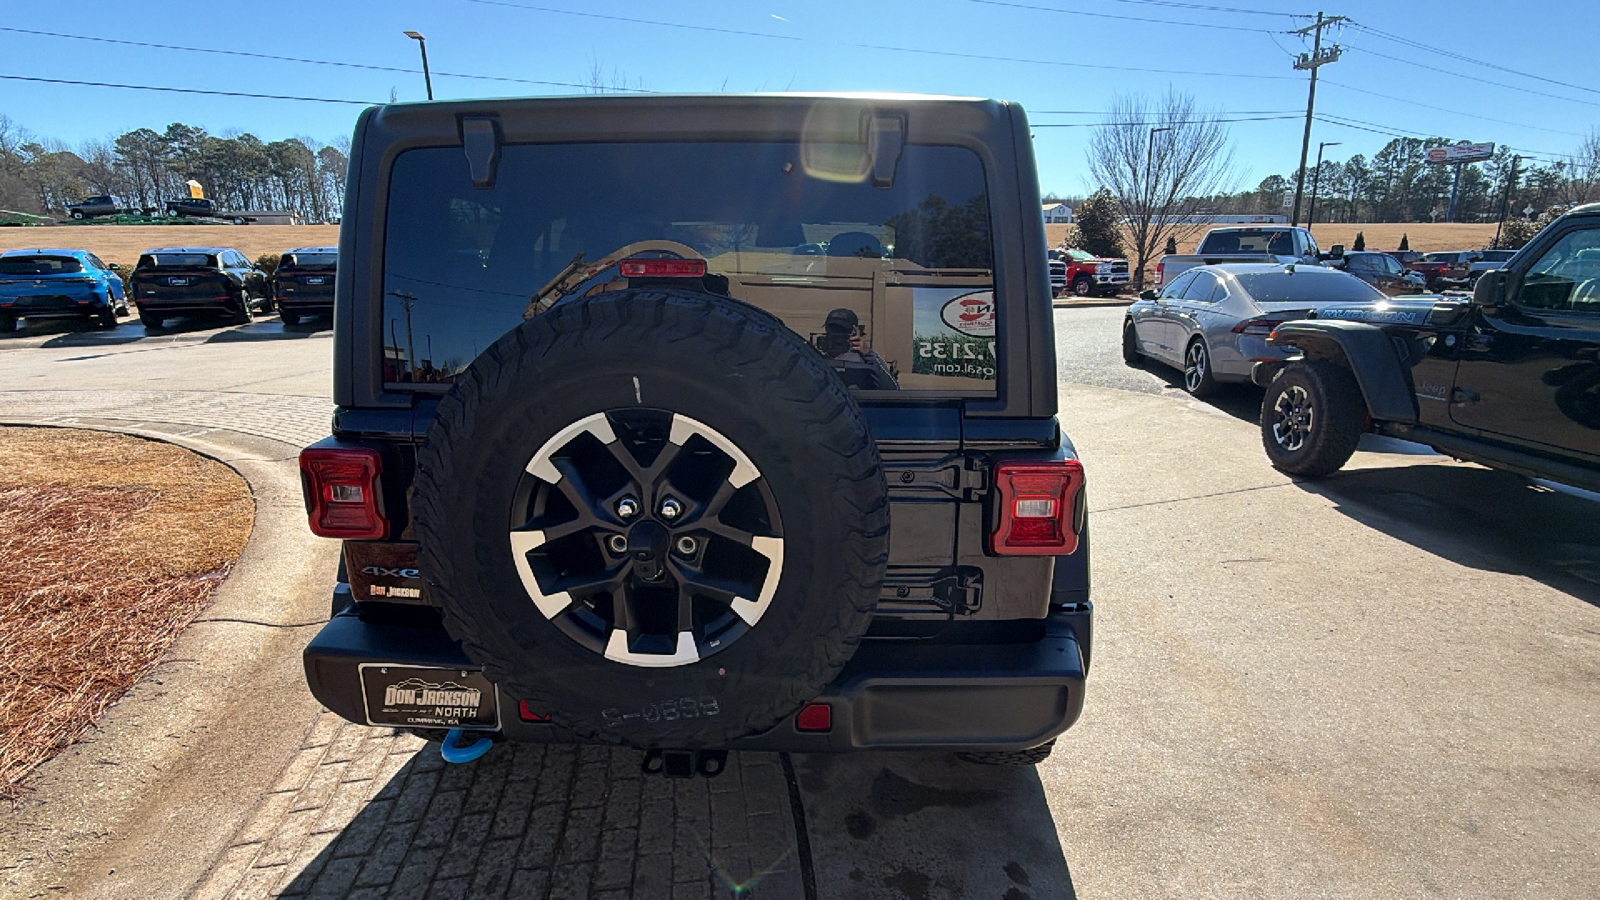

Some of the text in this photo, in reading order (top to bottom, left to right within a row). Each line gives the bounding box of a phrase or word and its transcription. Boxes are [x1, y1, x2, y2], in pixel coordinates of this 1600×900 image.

[1321, 309, 1417, 323] RUBICON
[1422, 380, 1446, 396] Jeep
[416, 689, 481, 708] JACKSON
[435, 706, 478, 718] NORTH
